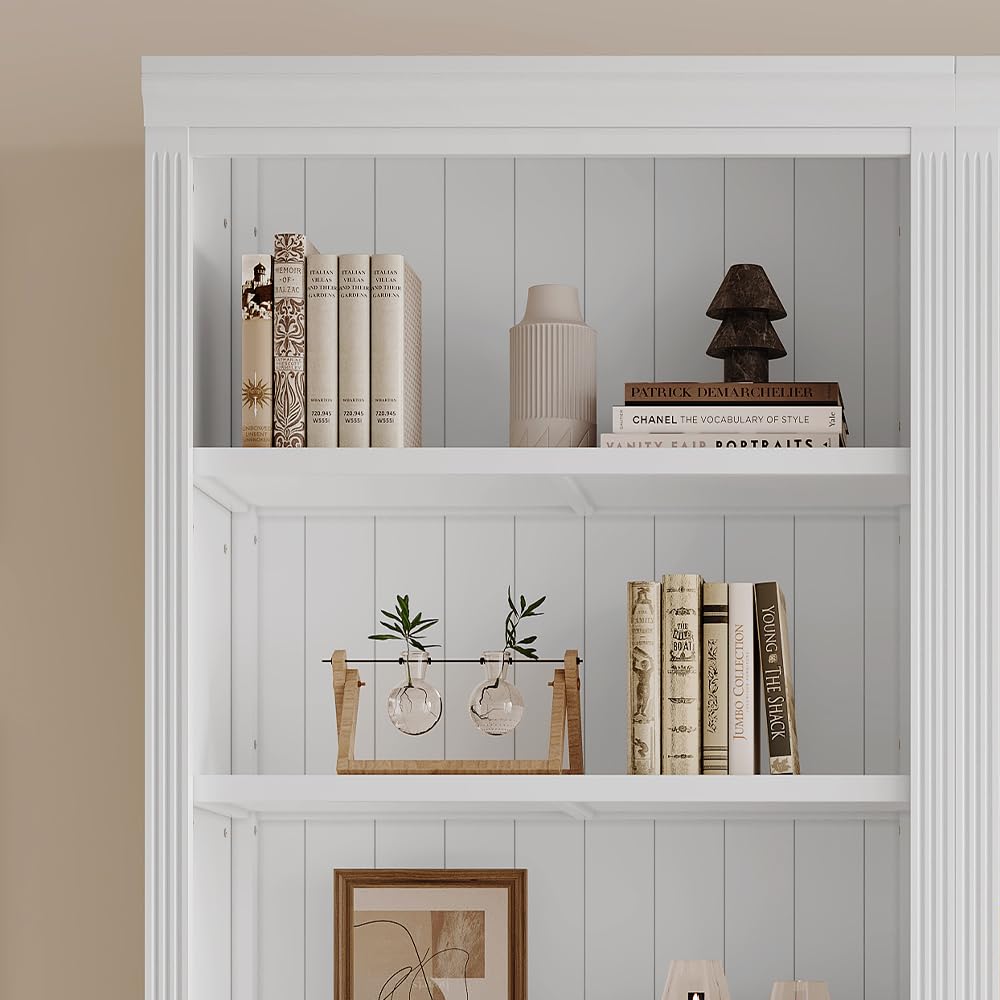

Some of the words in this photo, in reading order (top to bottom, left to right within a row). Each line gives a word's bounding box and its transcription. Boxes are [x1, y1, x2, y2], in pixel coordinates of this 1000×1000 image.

[631, 387, 692, 398] PATRICK
[698, 387, 813, 398] DEMARCHELIER
[632, 416, 677, 424] CHANEL
[680, 416, 698, 424] THE
[701, 416, 764, 424] VOCABULARY
[766, 416, 778, 424] OF
[781, 416, 810, 424] STYLE
[828, 411, 836, 428] Yale
[762, 605, 778, 653] YOUNG
[734, 624, 744, 697] COLLECTION
[765, 666, 782, 693] THE
[733, 701, 747, 740] JUMBO
[768, 696, 785, 741] SHACK
